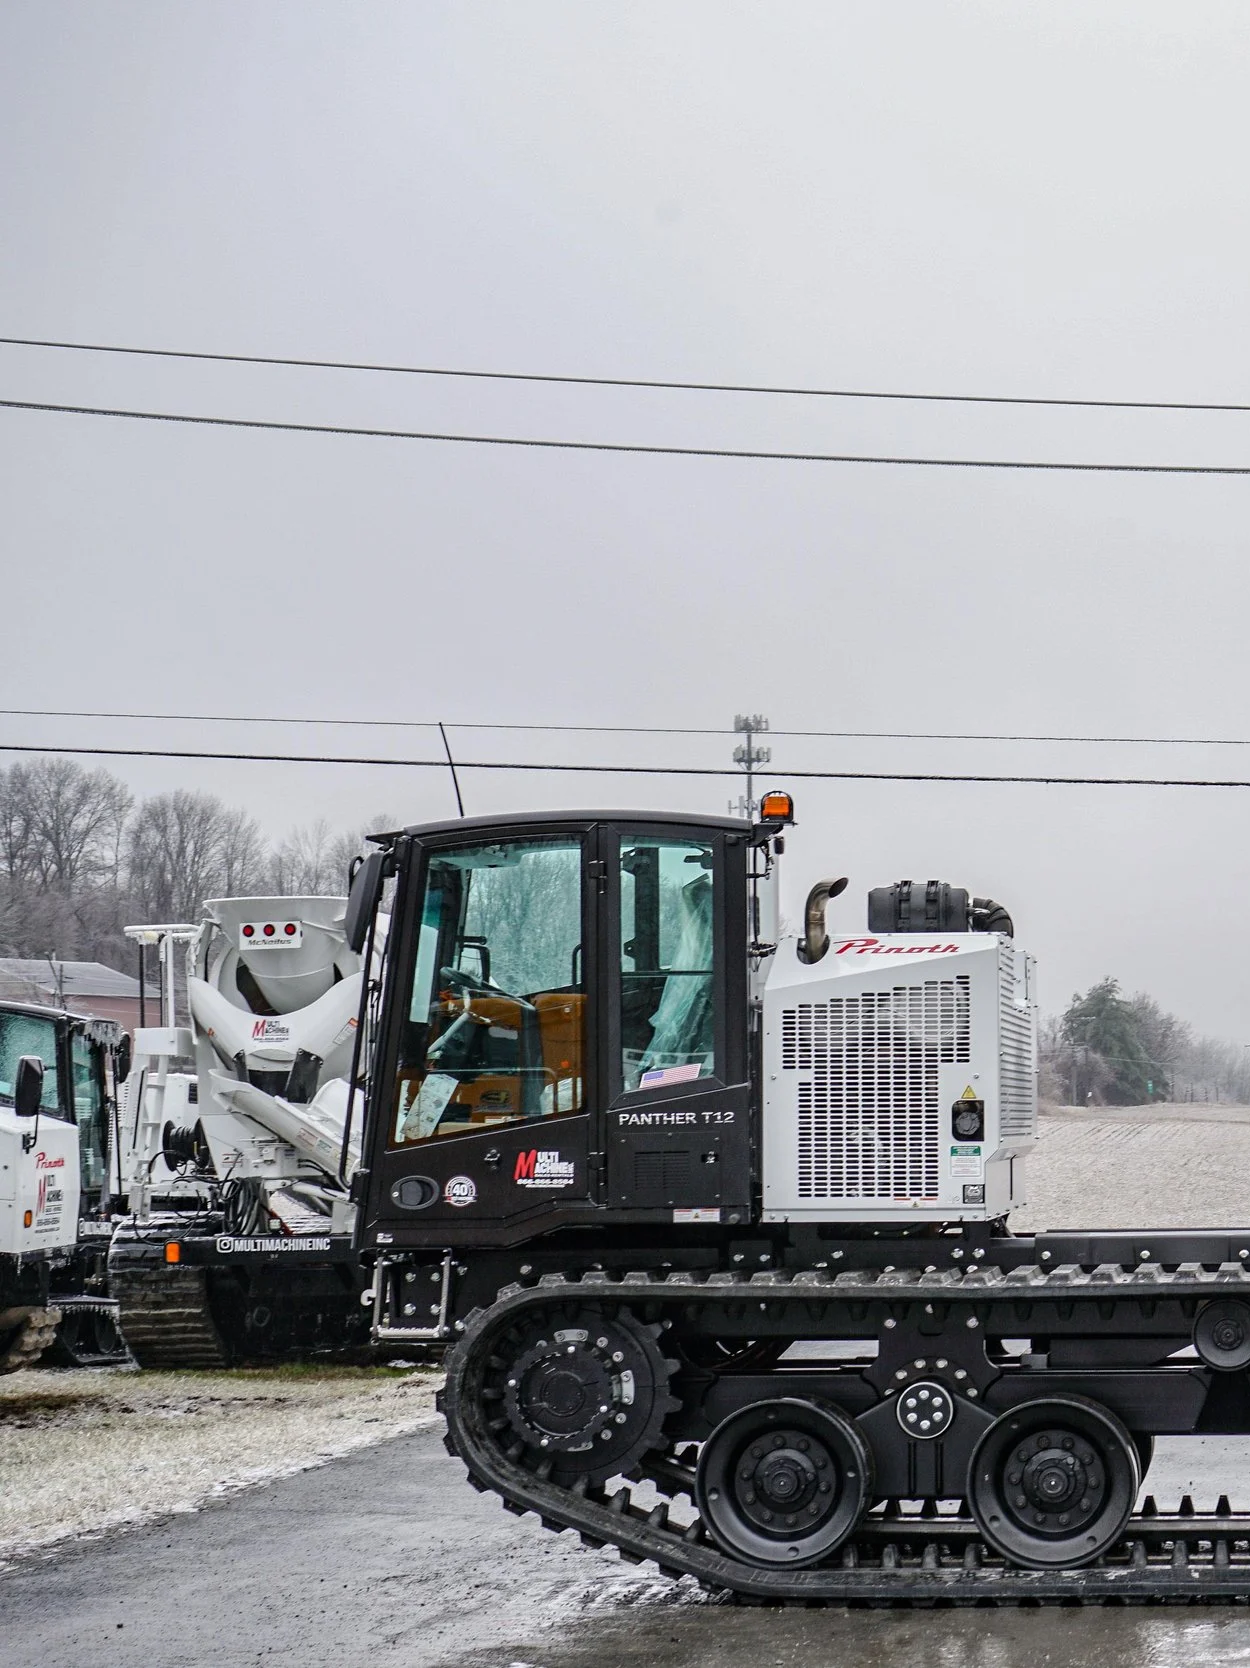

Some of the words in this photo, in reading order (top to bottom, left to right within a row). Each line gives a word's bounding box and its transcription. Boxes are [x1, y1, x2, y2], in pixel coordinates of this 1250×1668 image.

[833, 938, 960, 954] Prinoth
[618, 1113, 697, 1126] PANTHER
[701, 1111, 735, 1124] T12
[452, 1183, 469, 1196] 40
[234, 1238, 331, 1253] MULTIMACHINEINC
